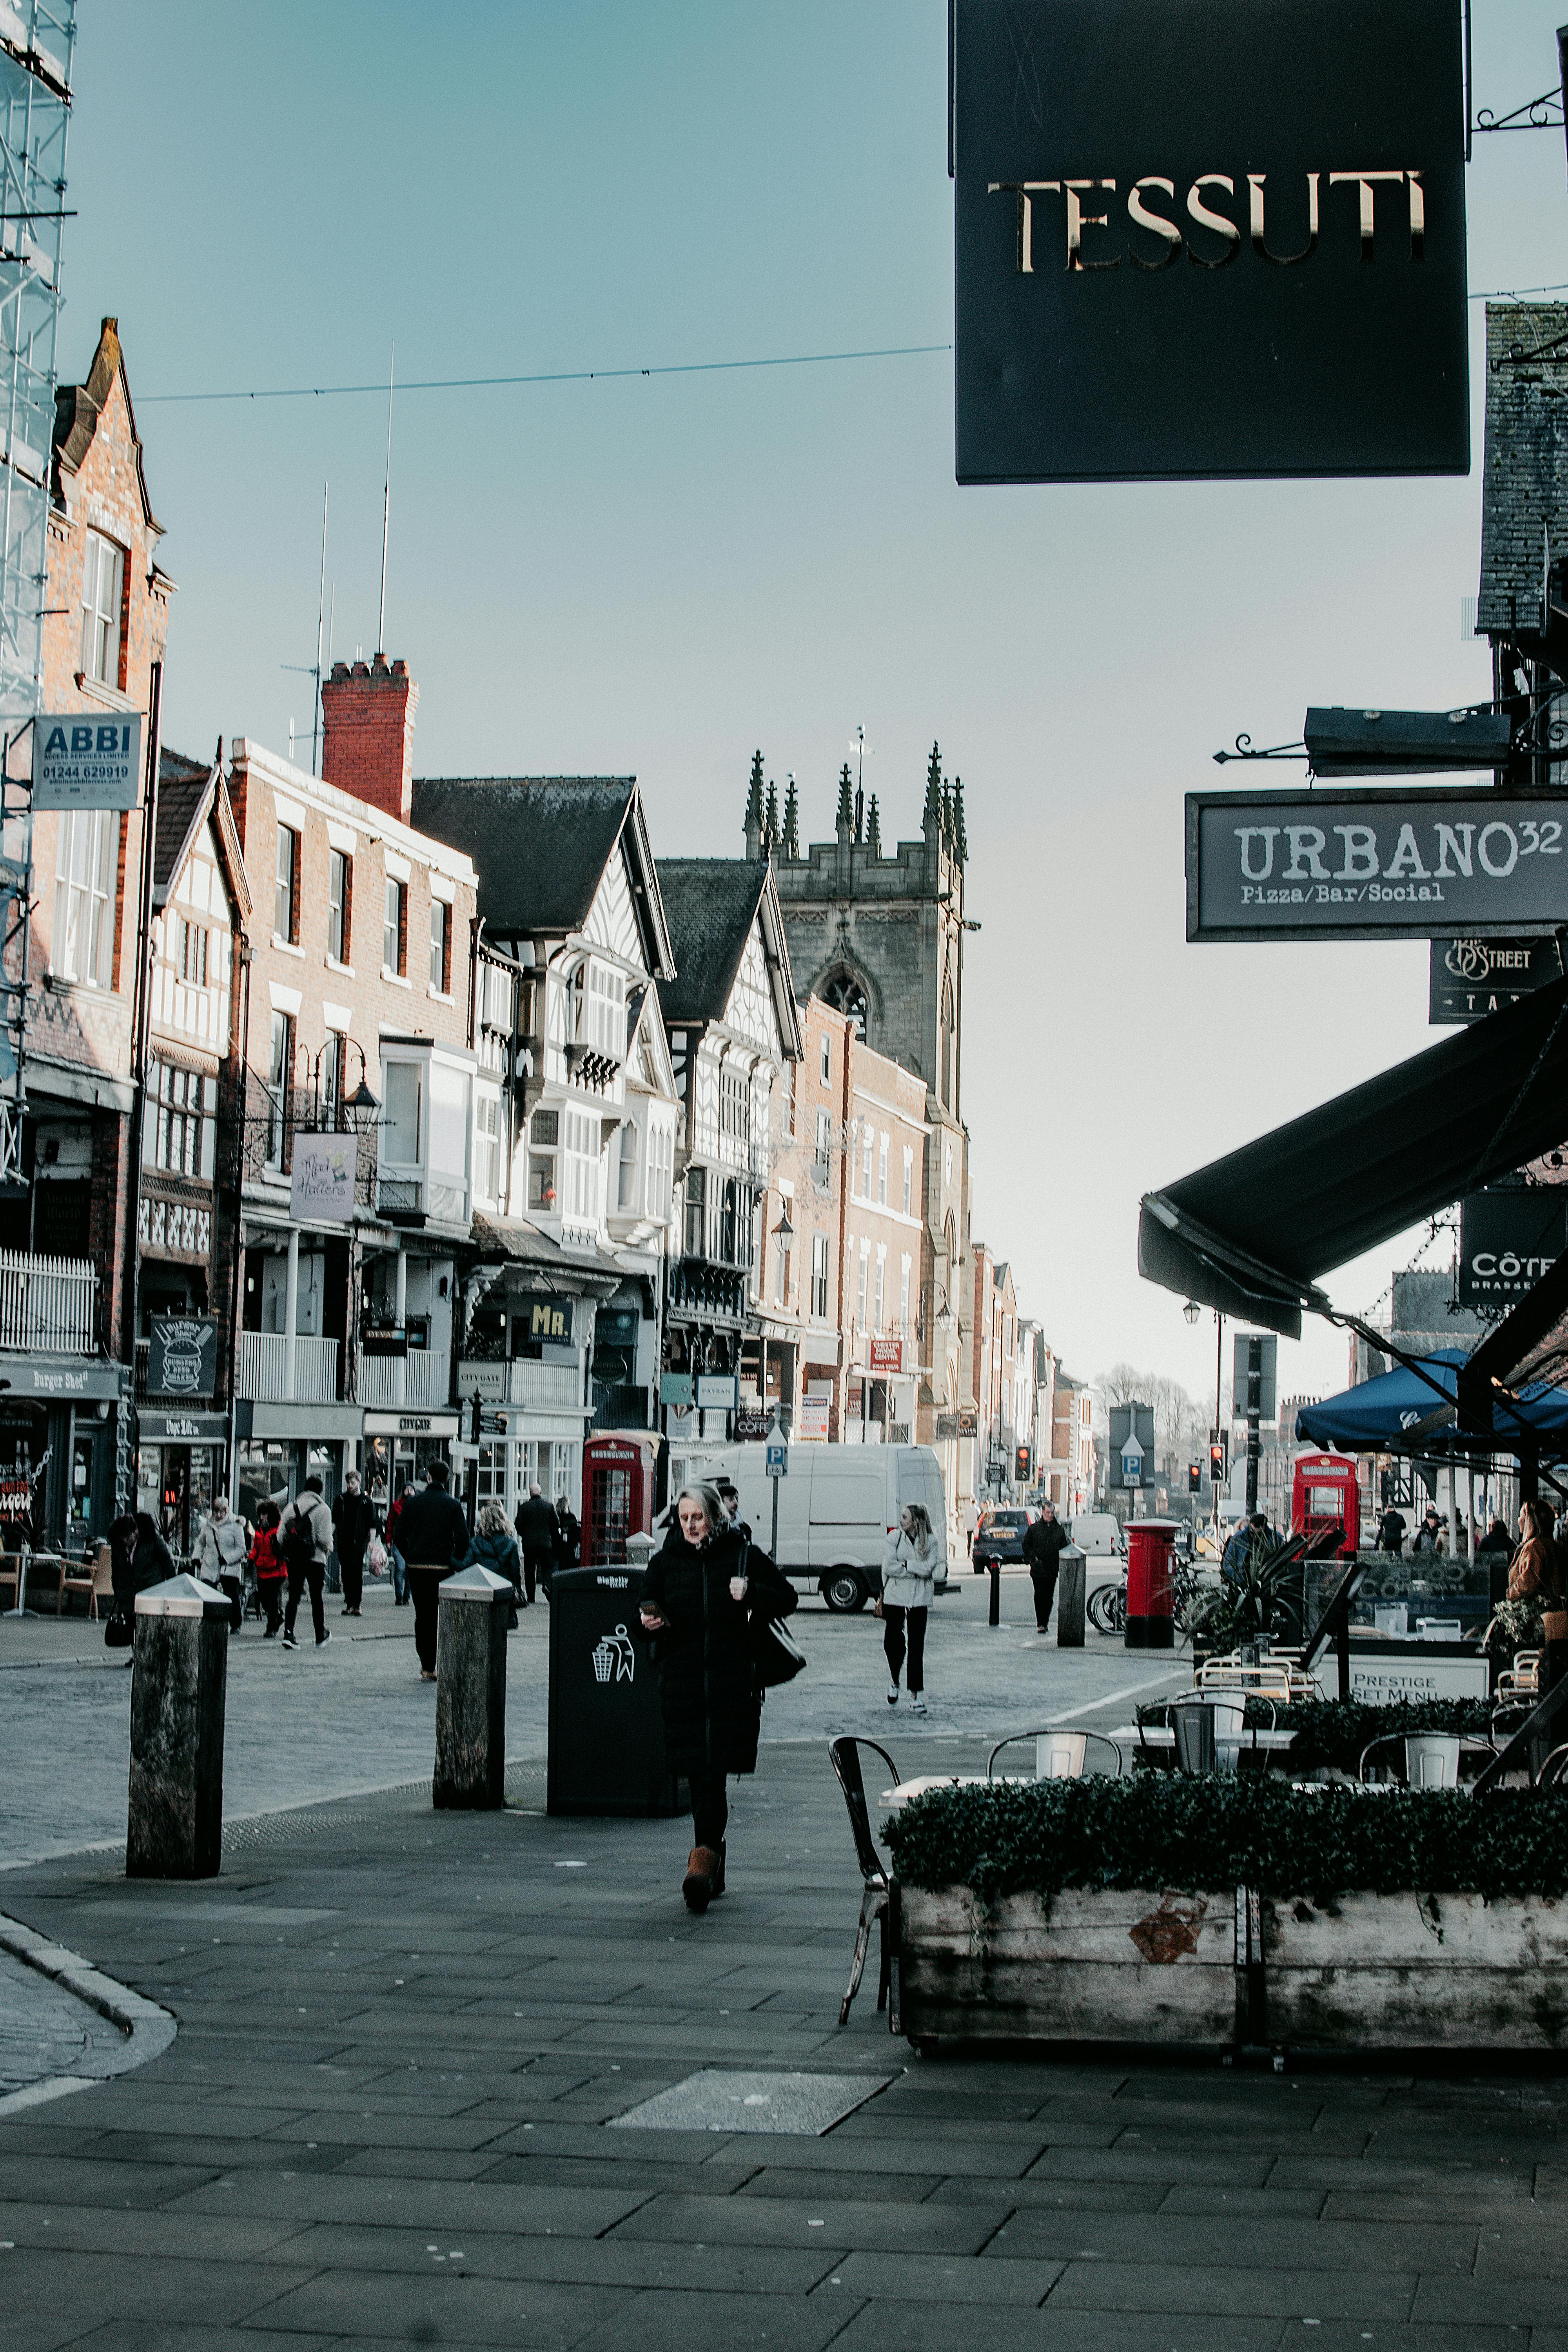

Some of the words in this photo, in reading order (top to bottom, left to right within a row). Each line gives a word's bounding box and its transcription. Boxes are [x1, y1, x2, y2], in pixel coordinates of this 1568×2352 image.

[988, 171, 1427, 272] TESSUTI
[45, 726, 131, 752] ABBI
[44, 751, 68, 760] ACCESS
[70, 751, 102, 760] SERVICES
[43, 766, 79, 779] 01244
[83, 765, 129, 778] 629919
[1241, 882, 1445, 904] Pizza/Bar/Social
[1472, 1280, 1535, 1290] BRASSE
[532, 1305, 568, 1336] MR.
[34, 1370, 63, 1392] Burger
[738, 1421, 769, 1434] COFFE
[771, 1447, 781, 1463] P
[1127, 1458, 1138, 1473] P
[1354, 1673, 1436, 1688] PRESTIGE
[1352, 1687, 1383, 1700] SET
[1388, 1689, 1438, 1701] MENU
